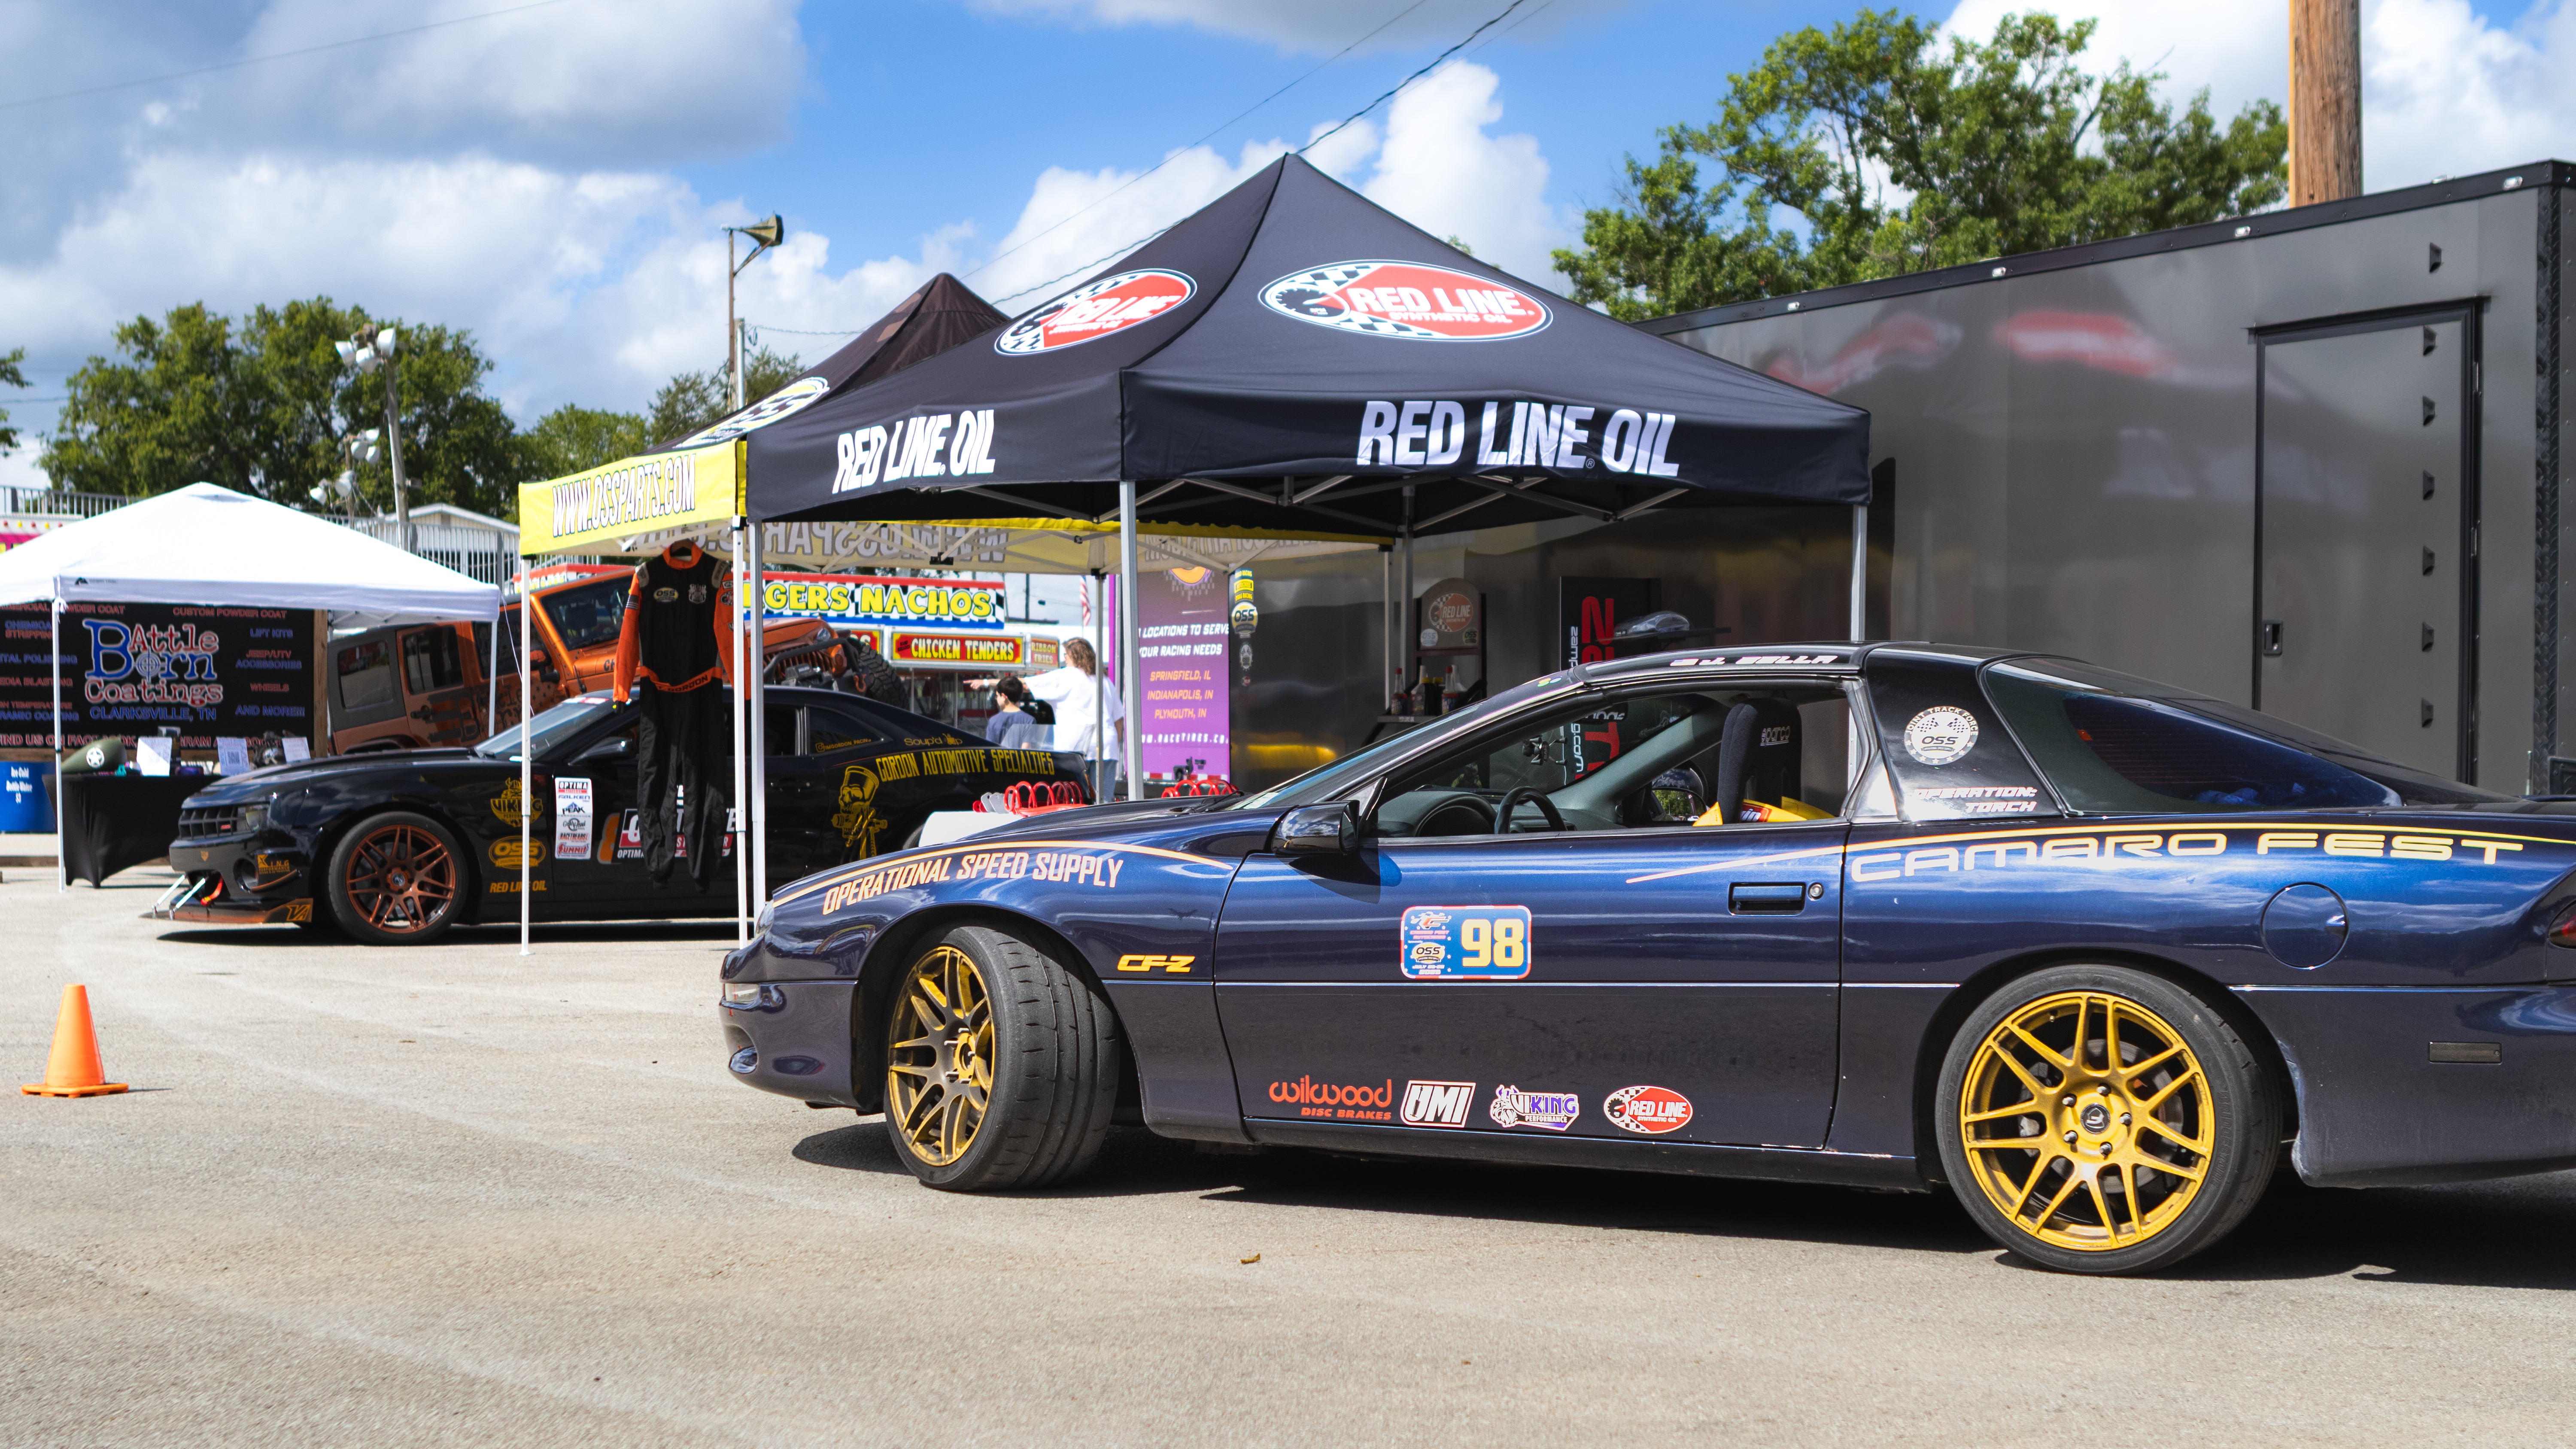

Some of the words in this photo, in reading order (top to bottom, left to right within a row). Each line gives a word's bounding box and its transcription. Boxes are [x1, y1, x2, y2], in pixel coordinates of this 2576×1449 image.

[1389, 312, 1481, 322] SYNTHETIC
[1487, 314, 1512, 323] OIL
[1357, 401, 1463, 465] RED
[1602, 410, 1680, 477] OIL
[832, 431, 888, 494] RED
[950, 410, 995, 477] OIL
[552, 454, 696, 538] WWW.OSSPARTS.COM
[744, 583, 850, 612] GERS
[860, 586, 992, 617] NACHOS
[97, 604, 125, 614] COAT
[173, 607, 213, 616] CUSTOM
[216, 608, 258, 617] POWDER
[260, 610, 287, 618] COAT
[1234, 609, 1255, 622] OSS
[5, 621, 52, 630] CHEMICA
[1142, 625, 1188, 638] LOCATIONS
[1190, 624, 1202, 635] TO
[911, 638, 961, 659] CHICKEN
[965, 640, 1015, 660] TENDERS
[1031, 642, 1056, 653] RIBBON
[1160, 645, 1191, 656] RACING
[1193, 644, 1222, 655] NEEDS
[1150, 670, 1201, 682] SPRINGFIELD,
[1204, 670, 1211, 680] IL
[85, 677, 223, 707] Coatings
[1147, 690, 1202, 701] INDIANAPOLIS,
[1205, 690, 1213, 699] IN
[90, 707, 194, 722] CLARKSVILLE,
[197, 708, 217, 720] TN
[235, 705, 260, 716] AND
[1154, 708, 1196, 720] PLYMOUTH,
[1198, 708, 1207, 718] IN
[1905, 712, 1925, 735] JOINT
[1962, 713, 1978, 735] FORCE
[0, 735, 22, 745] IND
[25, 734, 43, 745] US
[904, 737, 942, 746] Soup'd
[1922, 736, 1959, 745] OSS
[876, 753, 920, 782] GORDON
[923, 750, 988, 775] AUTOMOTIVE
[990, 749, 1055, 775] SPECIALTIES
[1965, 801, 2038, 813] TORCH
[1851, 833, 2227, 882] CAMARO
[2257, 833, 2523, 865] FEST
[489, 882, 509, 893] RED
[532, 880, 547, 891] OIL
[823, 857, 950, 915] OPERATIONAL
[957, 851, 1029, 880] SPEED
[1032, 852, 1124, 888] SUPPLY
[1461, 919, 1524, 967] 98
[1269, 1075, 1392, 1108] wilwood
[1403, 1085, 1470, 1122] UMI
[1510, 1094, 1577, 1115] VIKING
[1629, 1100, 1656, 1116] RED
[1301, 1107, 1332, 1117] DISC
[1337, 1109, 1391, 1120] BRAKES
